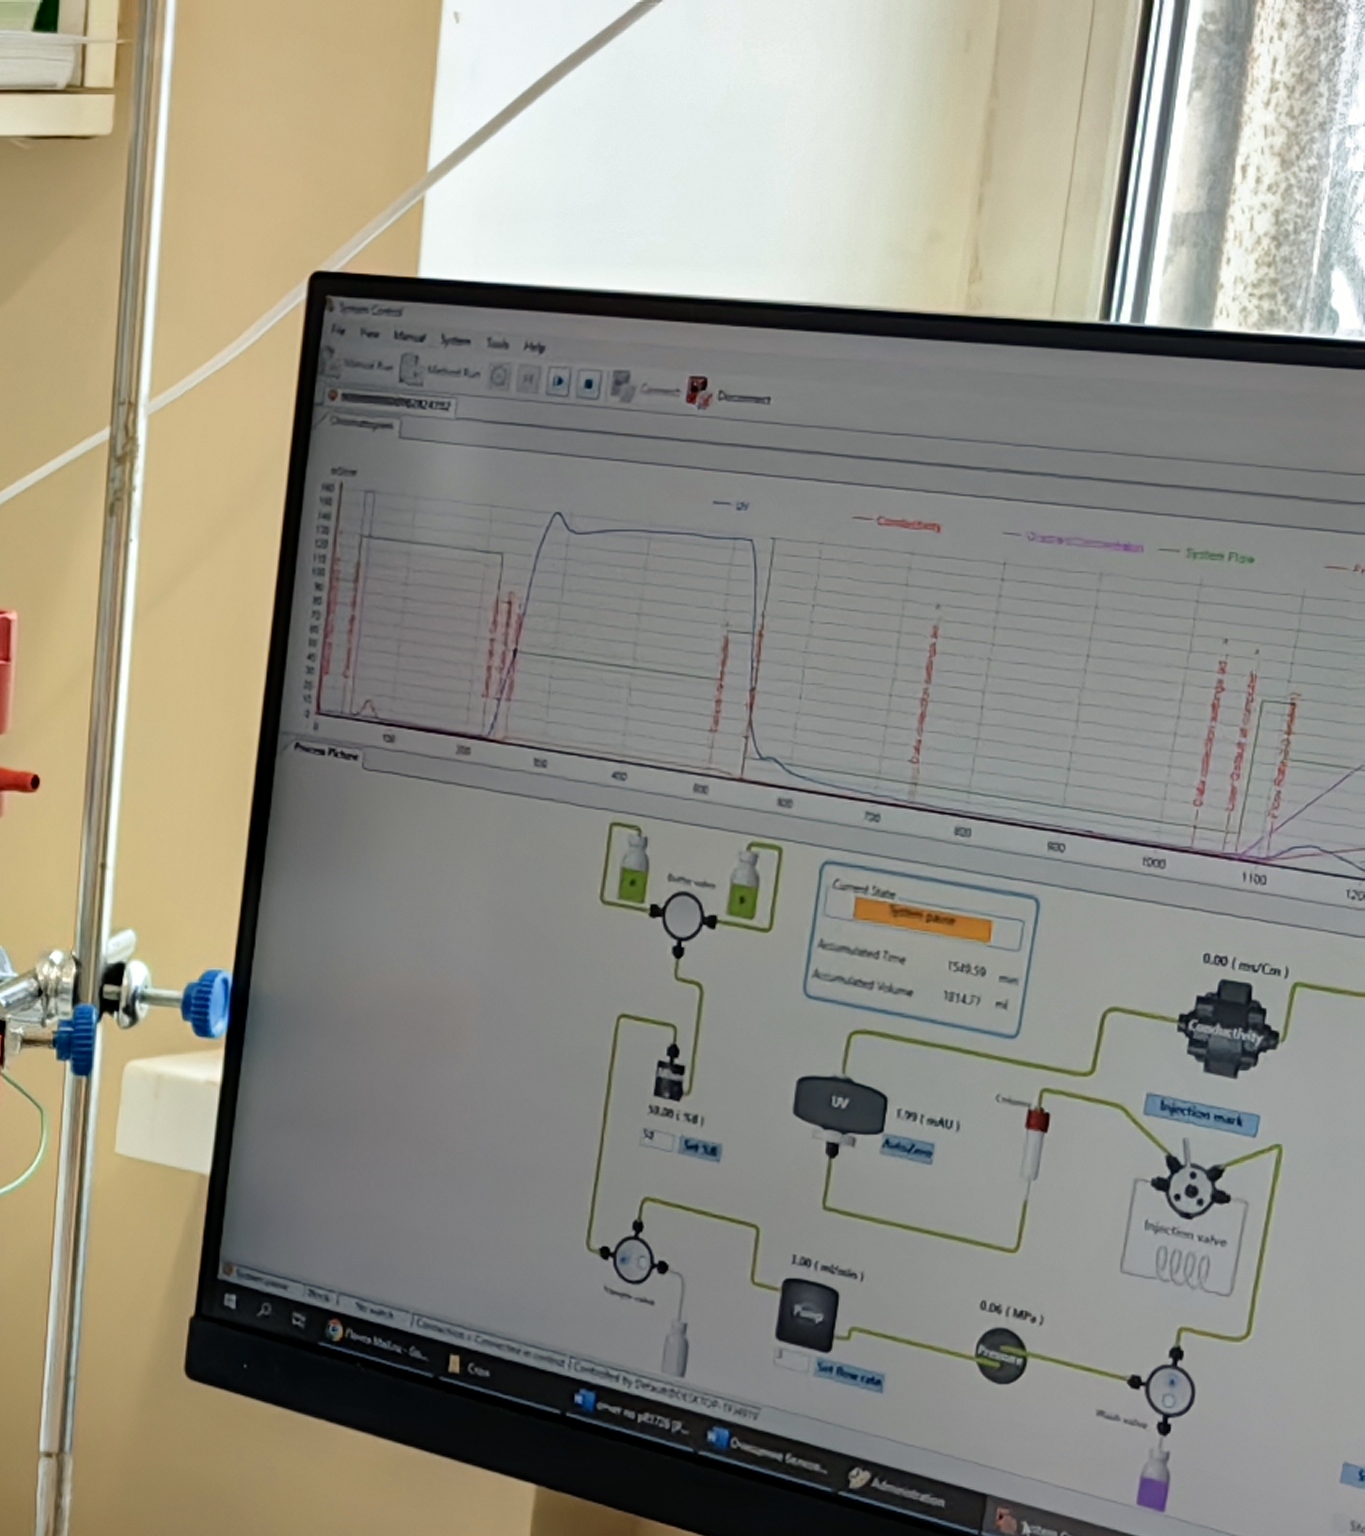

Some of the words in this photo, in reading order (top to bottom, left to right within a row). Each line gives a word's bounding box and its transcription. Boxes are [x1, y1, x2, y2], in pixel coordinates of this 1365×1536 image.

[1185, 546, 1225, 564] System
[1226, 551, 1256, 567] Flow
[1241, 872, 1268, 887] 1100
[882, 949, 908, 967] Time
[1187, 1018, 1265, 1046] Conductivity
[831, 1094, 850, 1110] UV
[1158, 1098, 1210, 1123] Injection
[1210, 1110, 1244, 1130] mark
[1143, 1218, 1195, 1242] Injection
[1196, 1232, 1229, 1249] valve
[815, 1360, 834, 1376] Set
